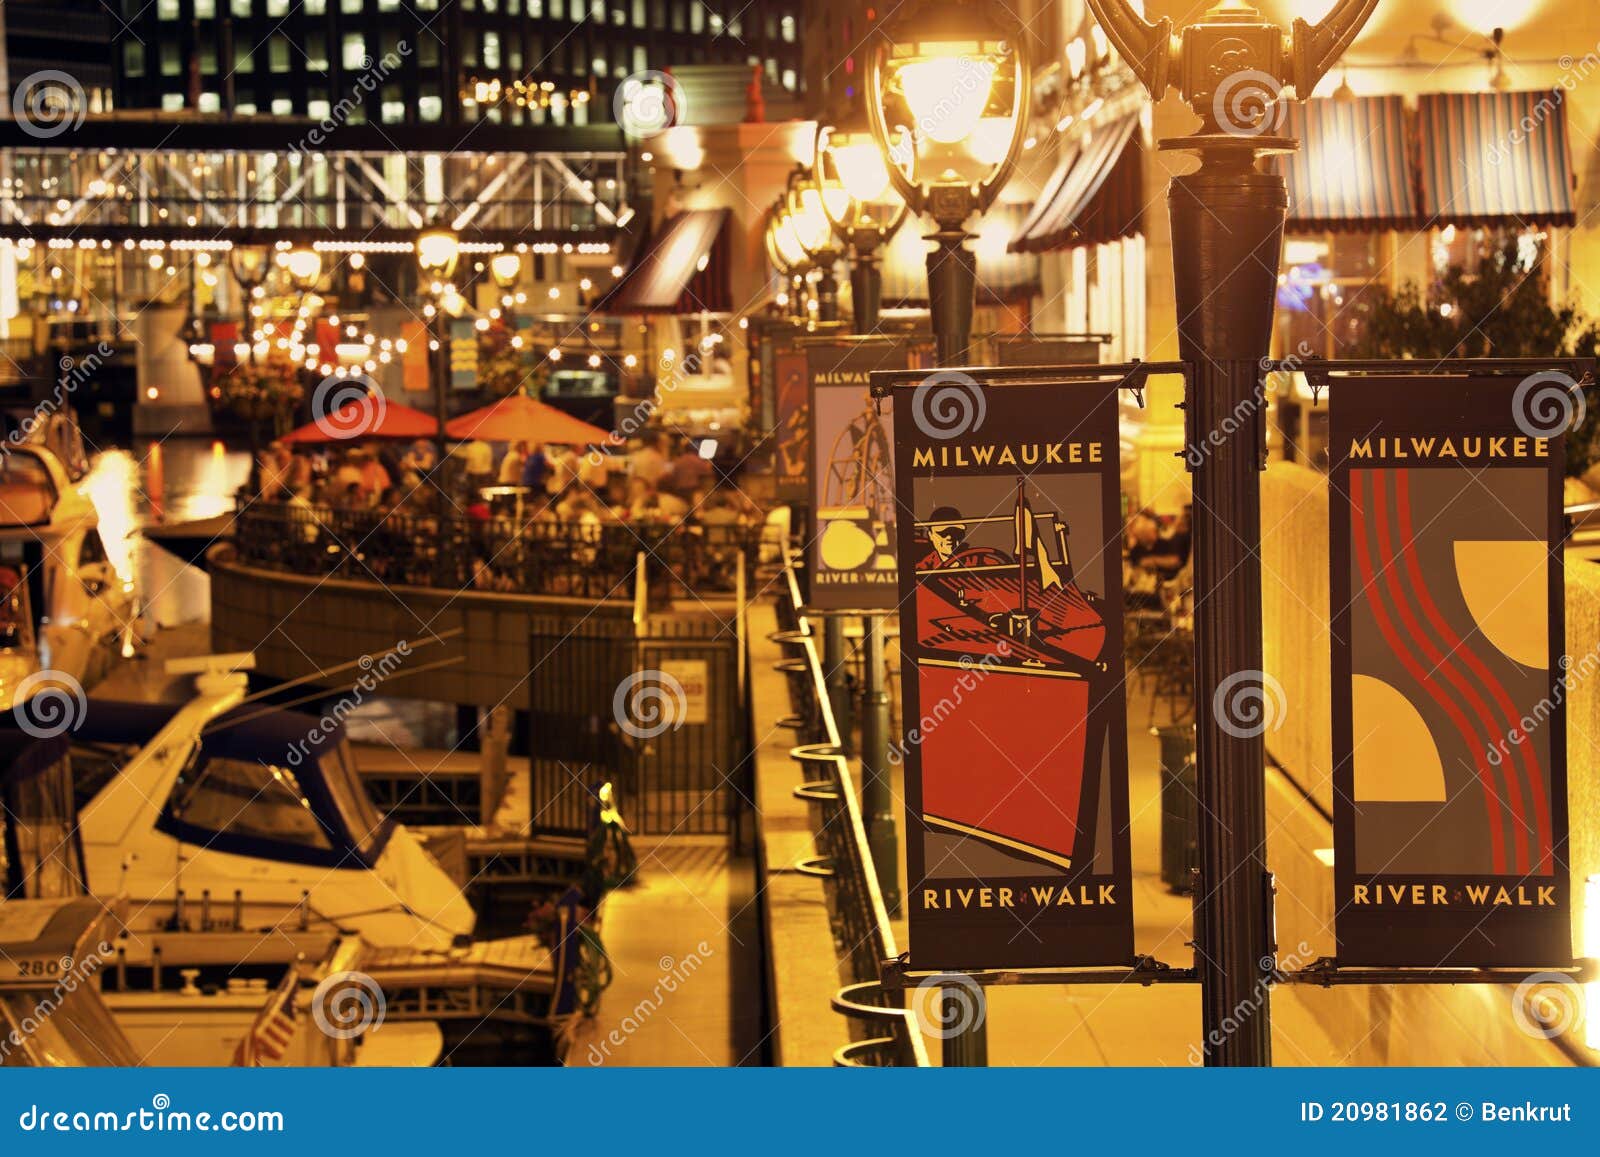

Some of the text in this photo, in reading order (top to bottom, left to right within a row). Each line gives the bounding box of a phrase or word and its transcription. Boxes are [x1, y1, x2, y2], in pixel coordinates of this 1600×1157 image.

[815, 372, 871, 384] MILWAU
[912, 442, 1102, 467] MILWAUKEE
[1349, 437, 1549, 458] MILWAUKEE
[816, 572, 859, 584] RIVER
[924, 885, 1117, 909] RIVER WALK
[1354, 884, 1556, 906] RIVER WALK
